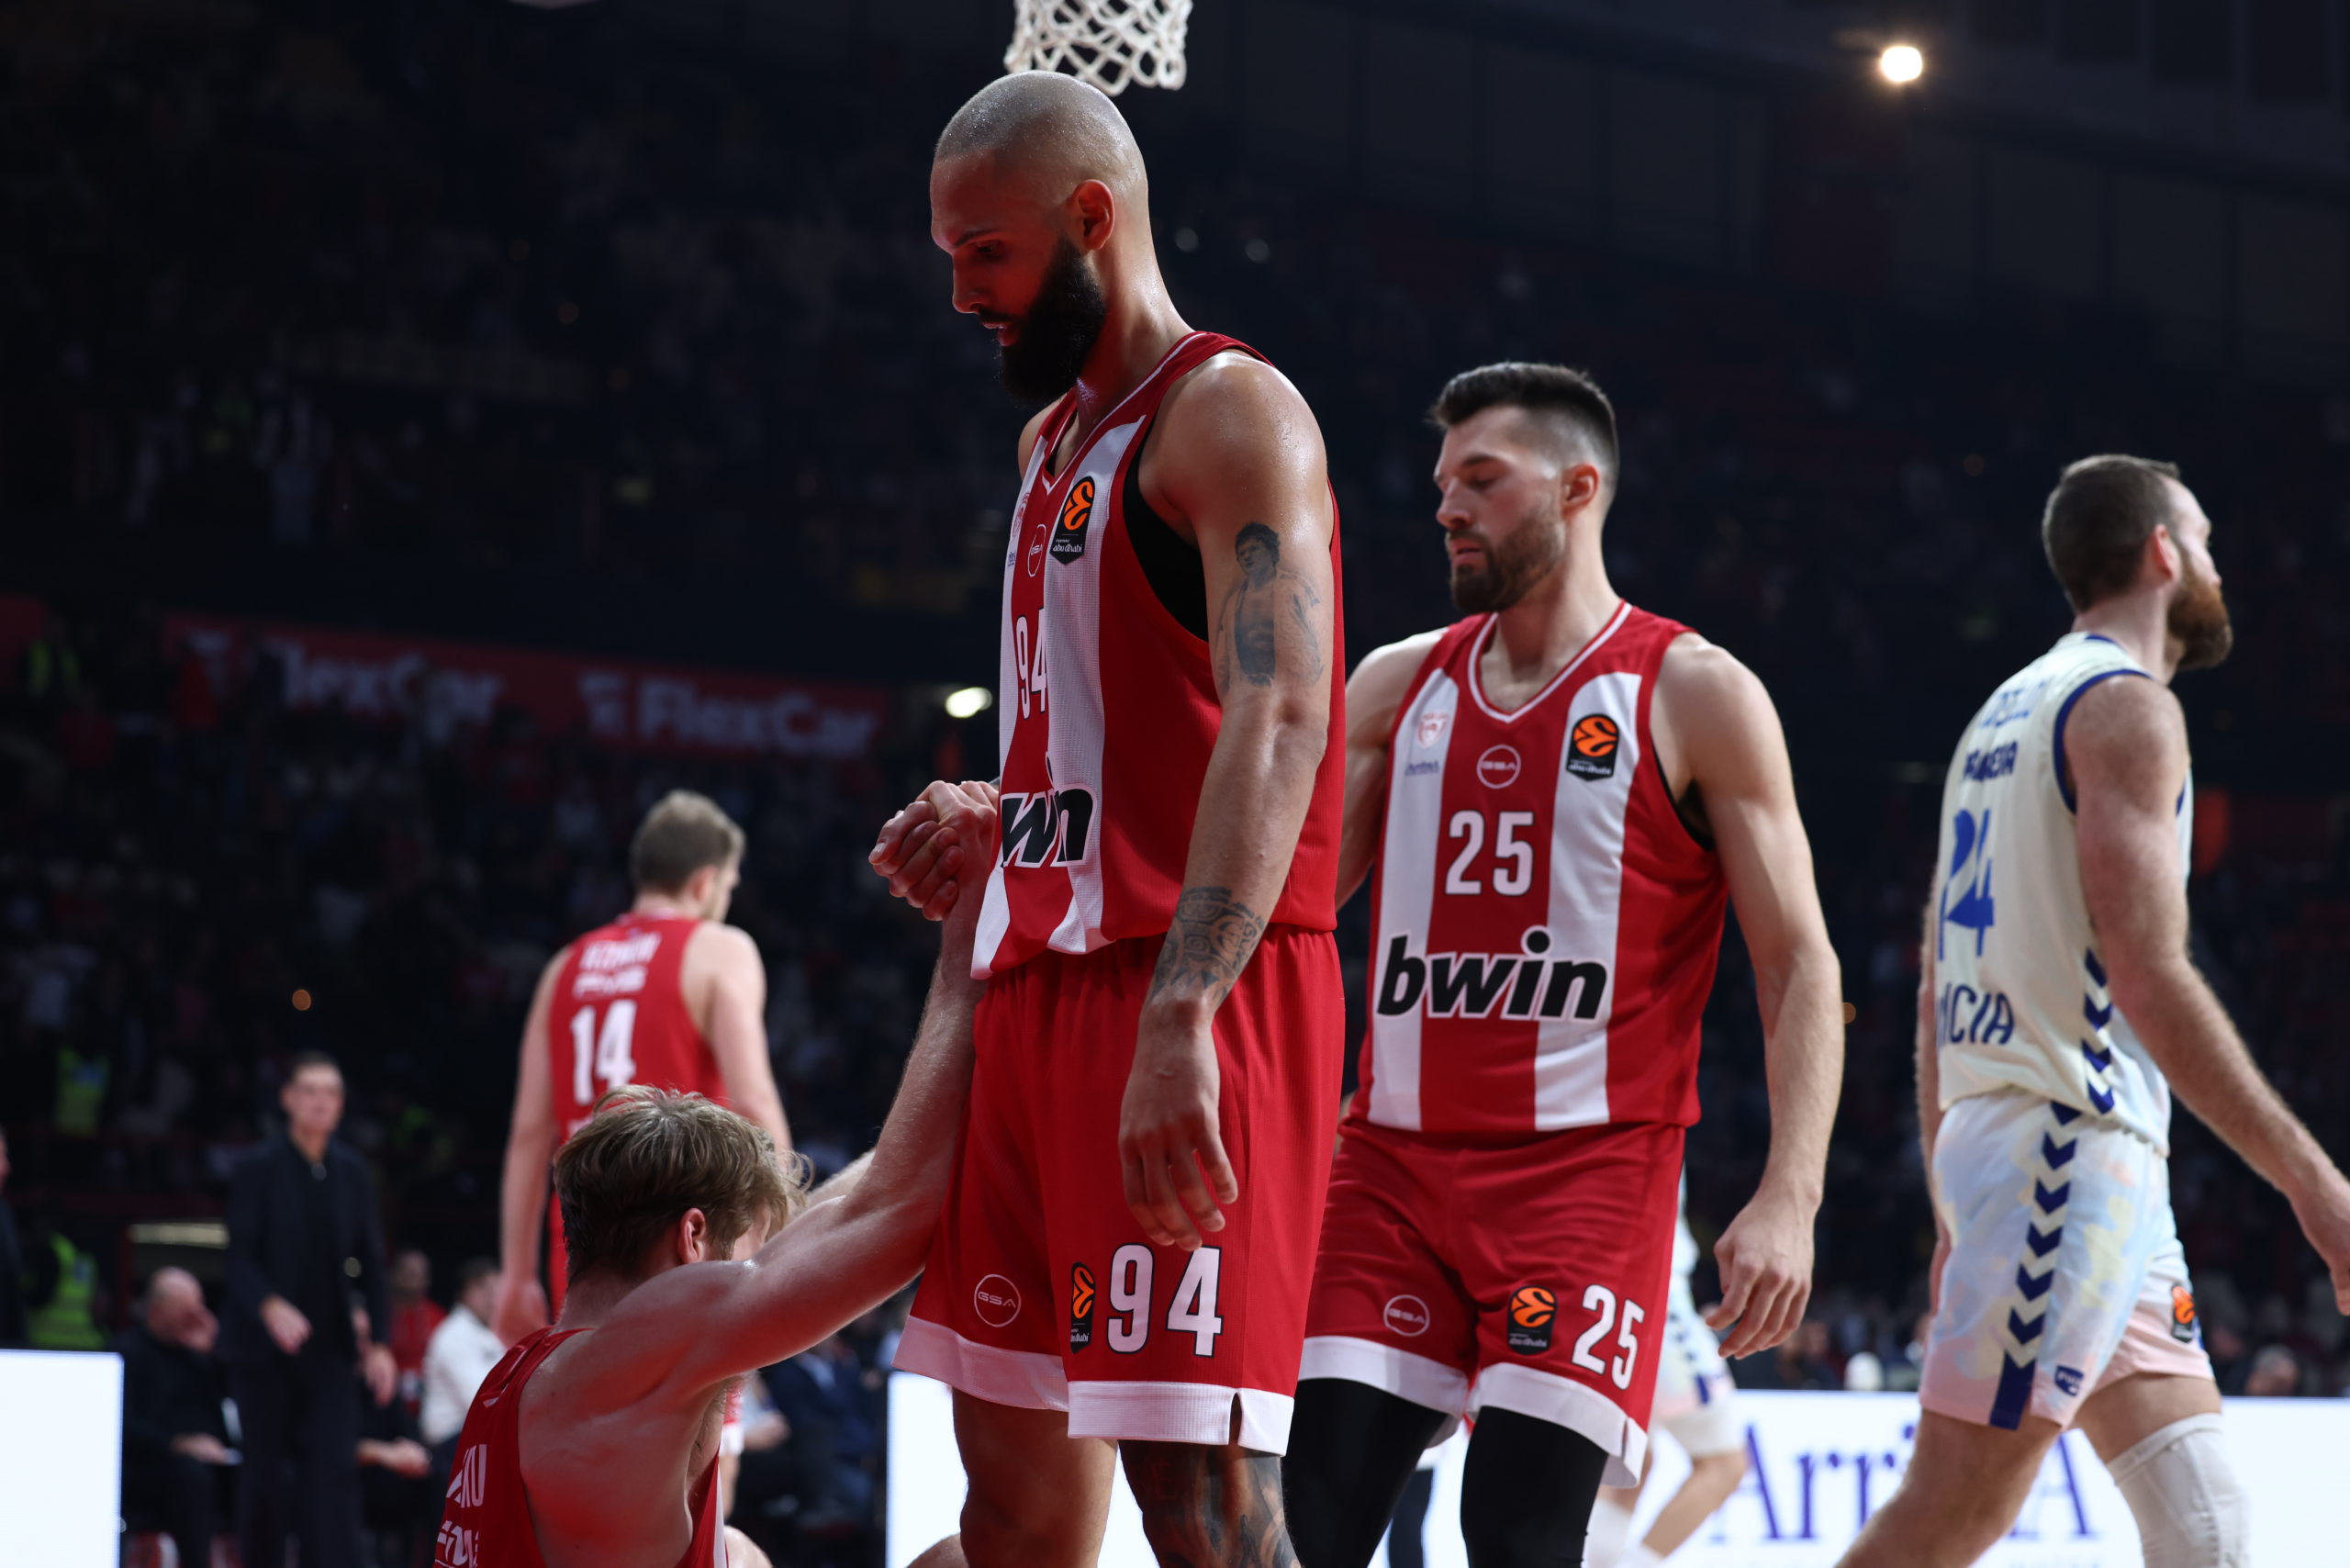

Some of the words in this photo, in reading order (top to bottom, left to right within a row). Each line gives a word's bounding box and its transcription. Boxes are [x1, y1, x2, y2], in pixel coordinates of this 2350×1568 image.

[261, 634, 504, 728] lexCar
[1015, 607, 1048, 720] 94
[638, 678, 878, 758] FlexCar
[1445, 809, 1534, 896] 25
[1374, 927, 1608, 1021] bwin
[569, 998, 637, 1106] 14
[978, 1291, 1016, 1308] GSA
[1107, 1242, 1224, 1358] 94
[1572, 1283, 1646, 1391] 25
